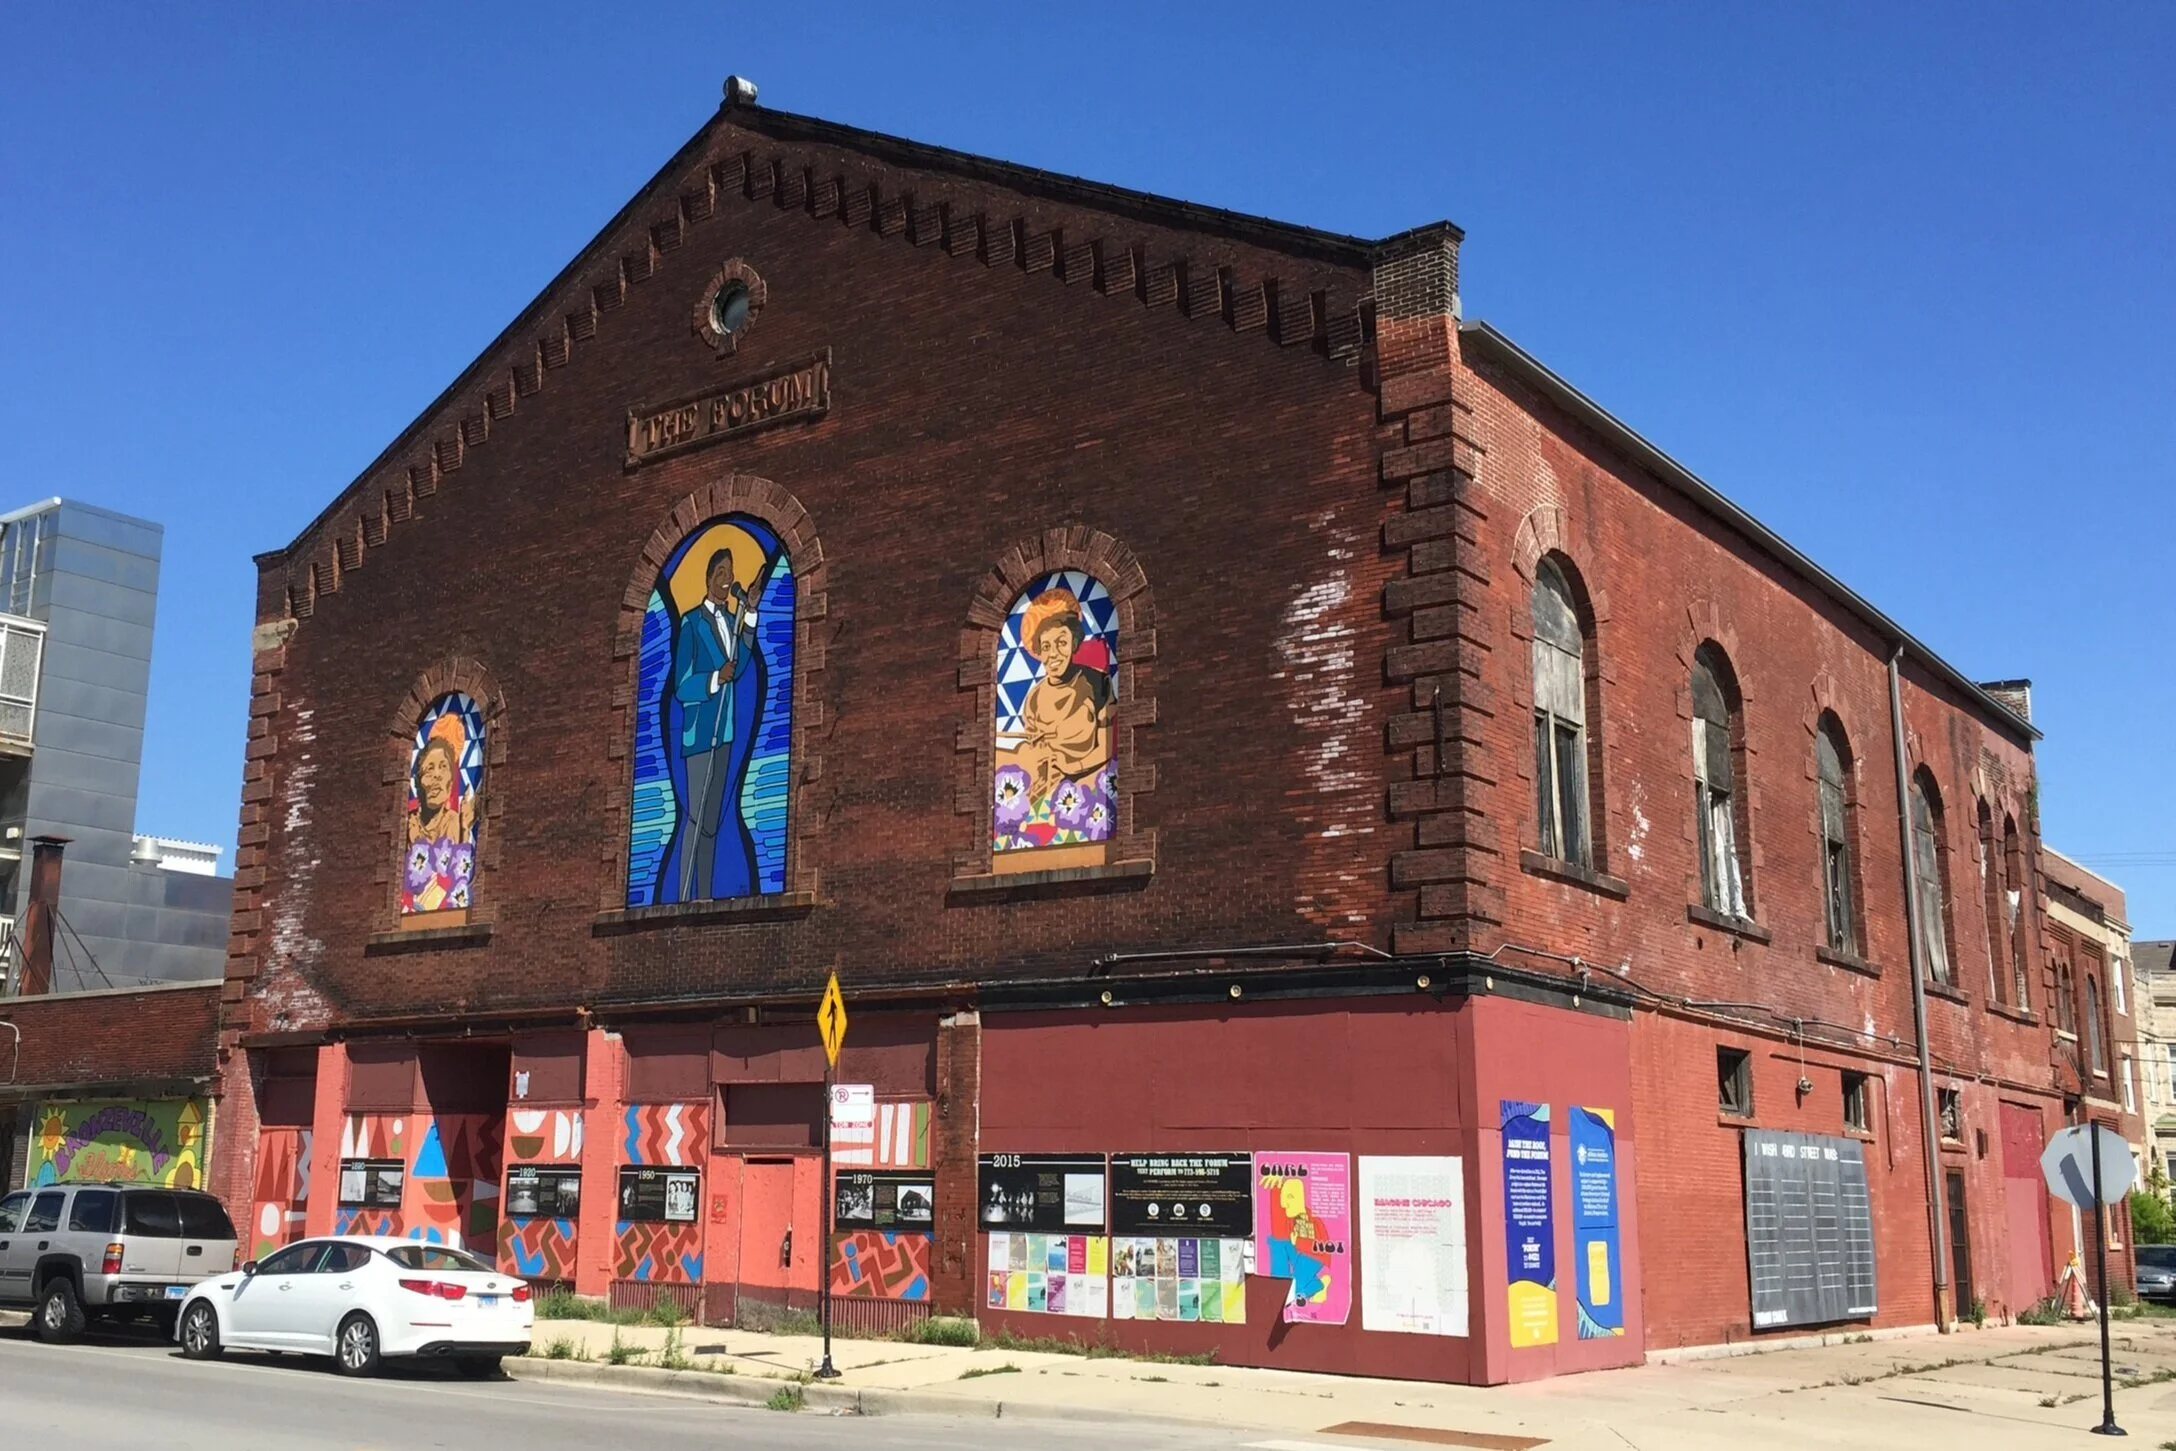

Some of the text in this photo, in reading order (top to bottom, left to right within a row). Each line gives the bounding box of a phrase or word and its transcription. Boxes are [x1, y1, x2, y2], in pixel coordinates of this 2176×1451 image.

[647, 369, 813, 444] THE FORUM
[1800, 1145, 1820, 1160] STREET
[993, 1154, 1021, 1168] 2015
[1130, 1159, 1228, 1167] HELP BRING BACK THE FORUM
[852, 1174, 873, 1184] 1970
